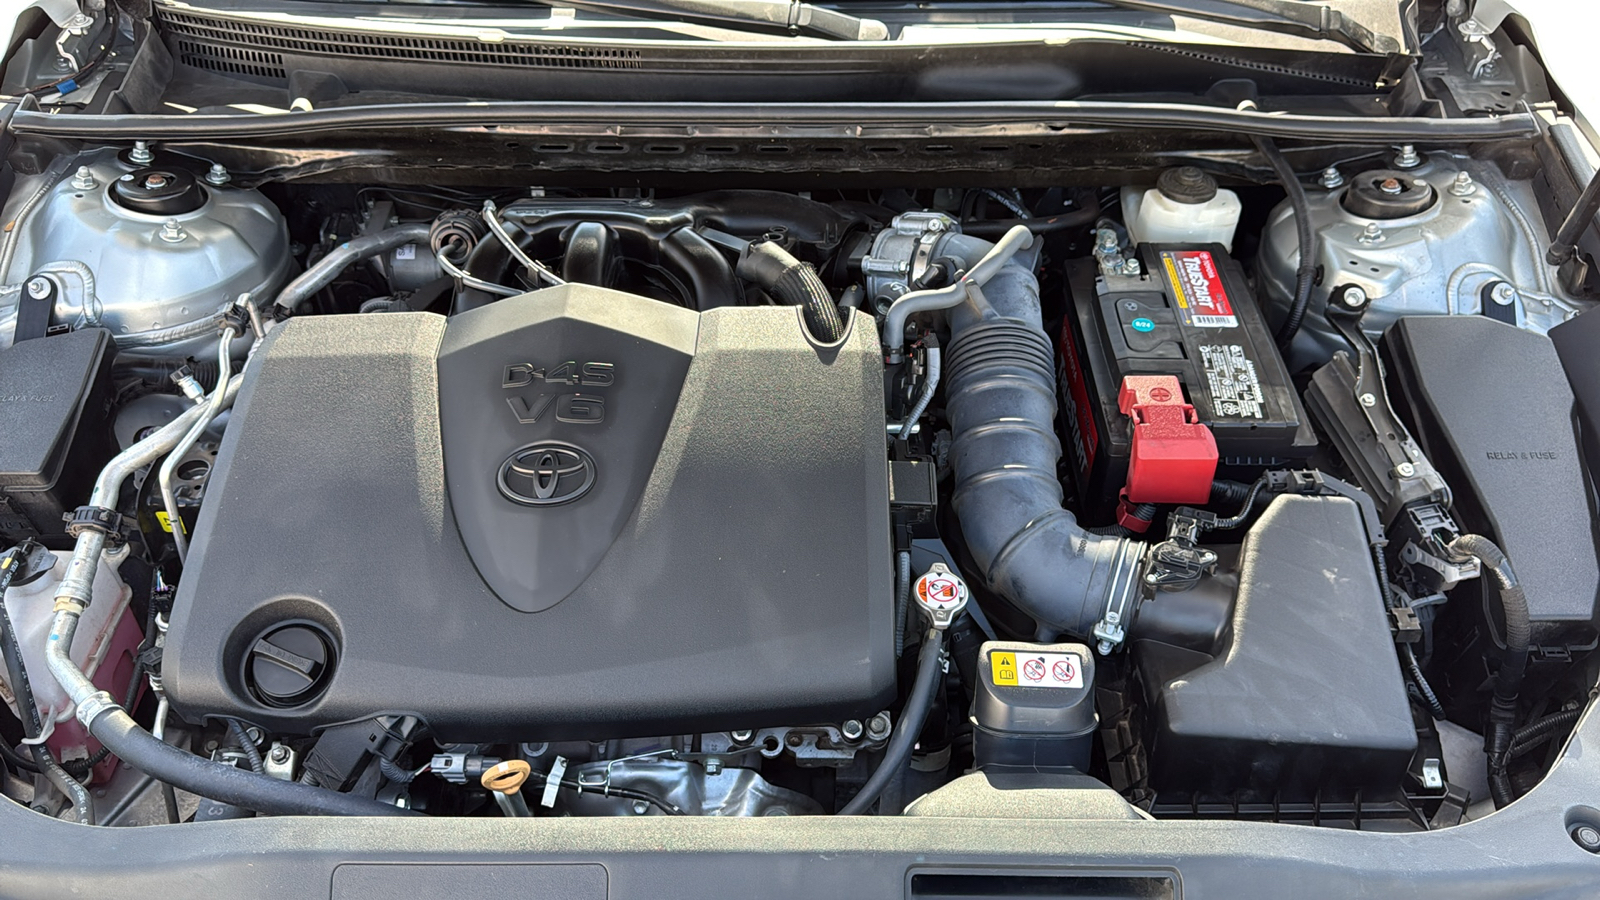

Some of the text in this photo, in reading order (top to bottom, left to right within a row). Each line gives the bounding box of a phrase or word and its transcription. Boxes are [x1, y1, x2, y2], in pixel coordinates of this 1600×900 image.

[1203, 257, 1215, 279] TOYOTA
[1182, 256, 1213, 309] TRUESTART
[30, 394, 56, 402] FUSE
[506, 393, 605, 425] V6
[1059, 351, 1088, 473] TRUESTART
[1486, 451, 1556, 460] RELAY & FUSE
